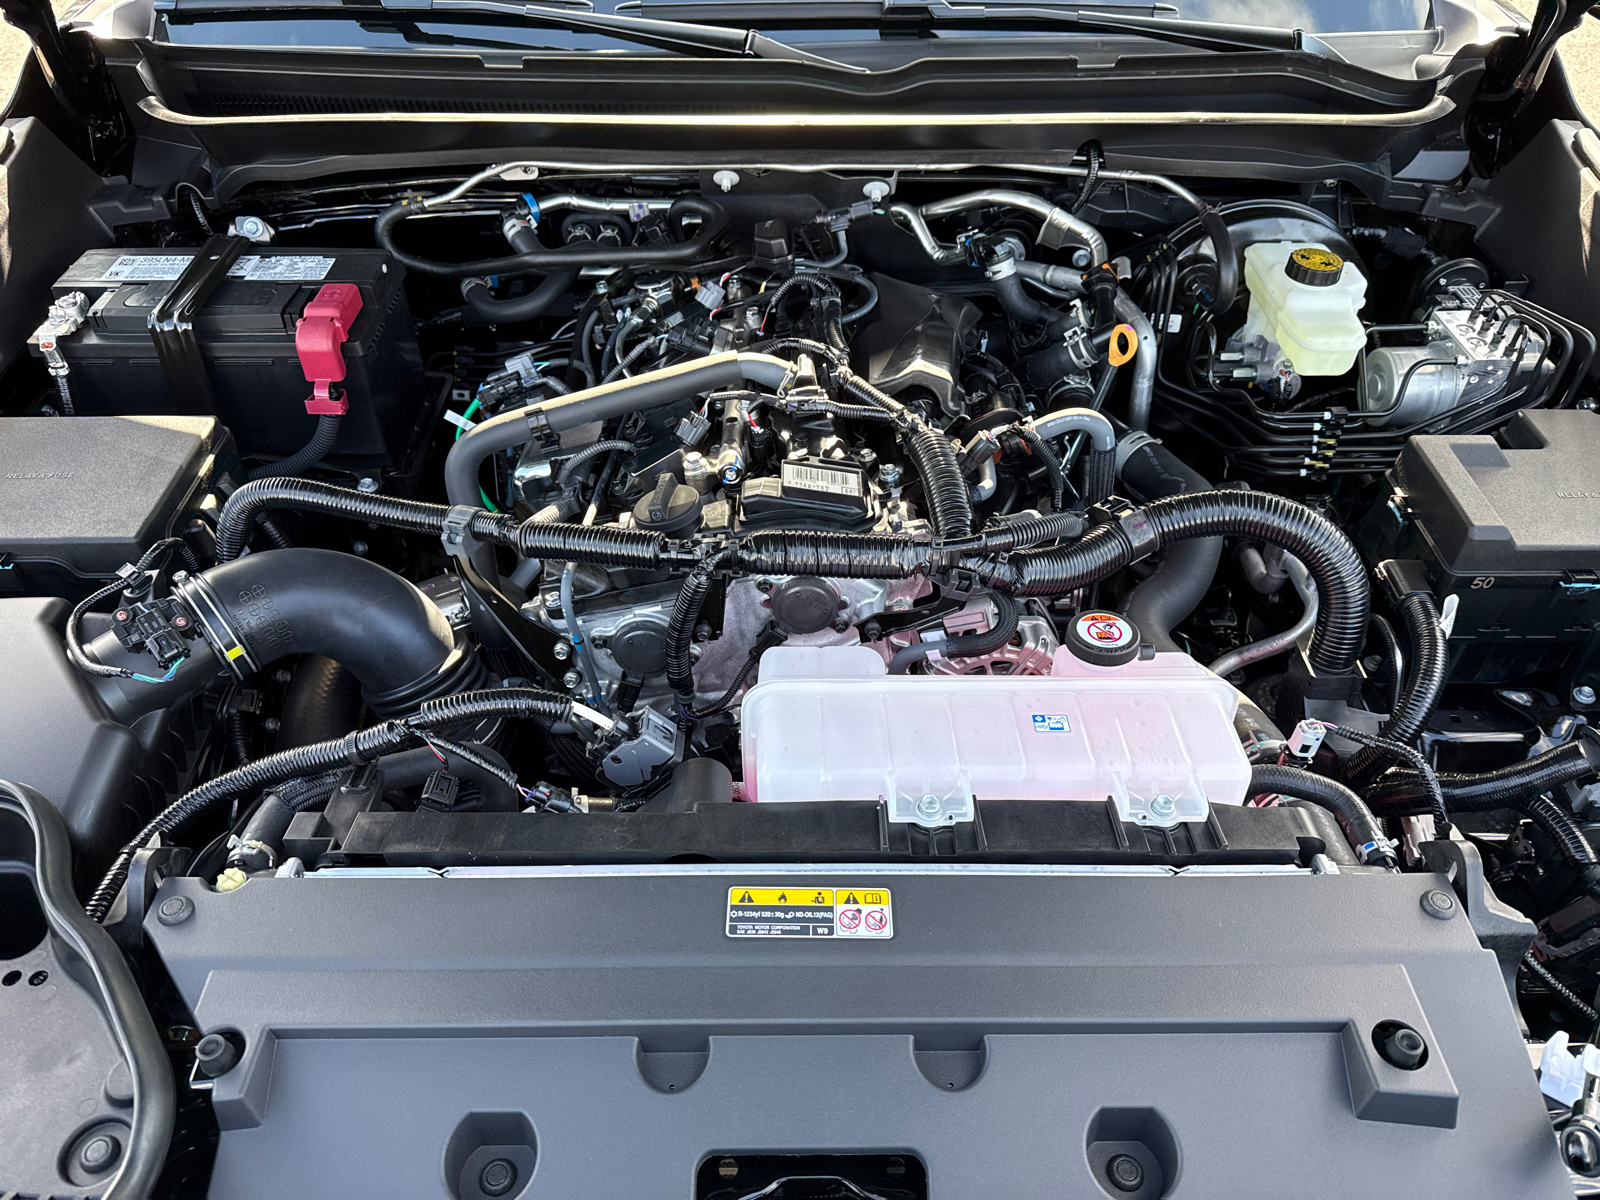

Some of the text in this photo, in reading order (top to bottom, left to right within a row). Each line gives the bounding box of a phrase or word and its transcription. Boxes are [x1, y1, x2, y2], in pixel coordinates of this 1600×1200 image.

[5, 472, 40, 480] RELAY
[47, 472, 76, 480] FUSE
[1556, 491, 1589, 499] RELAY
[1470, 576, 1495, 590] 50
[816, 927, 829, 935] W9
